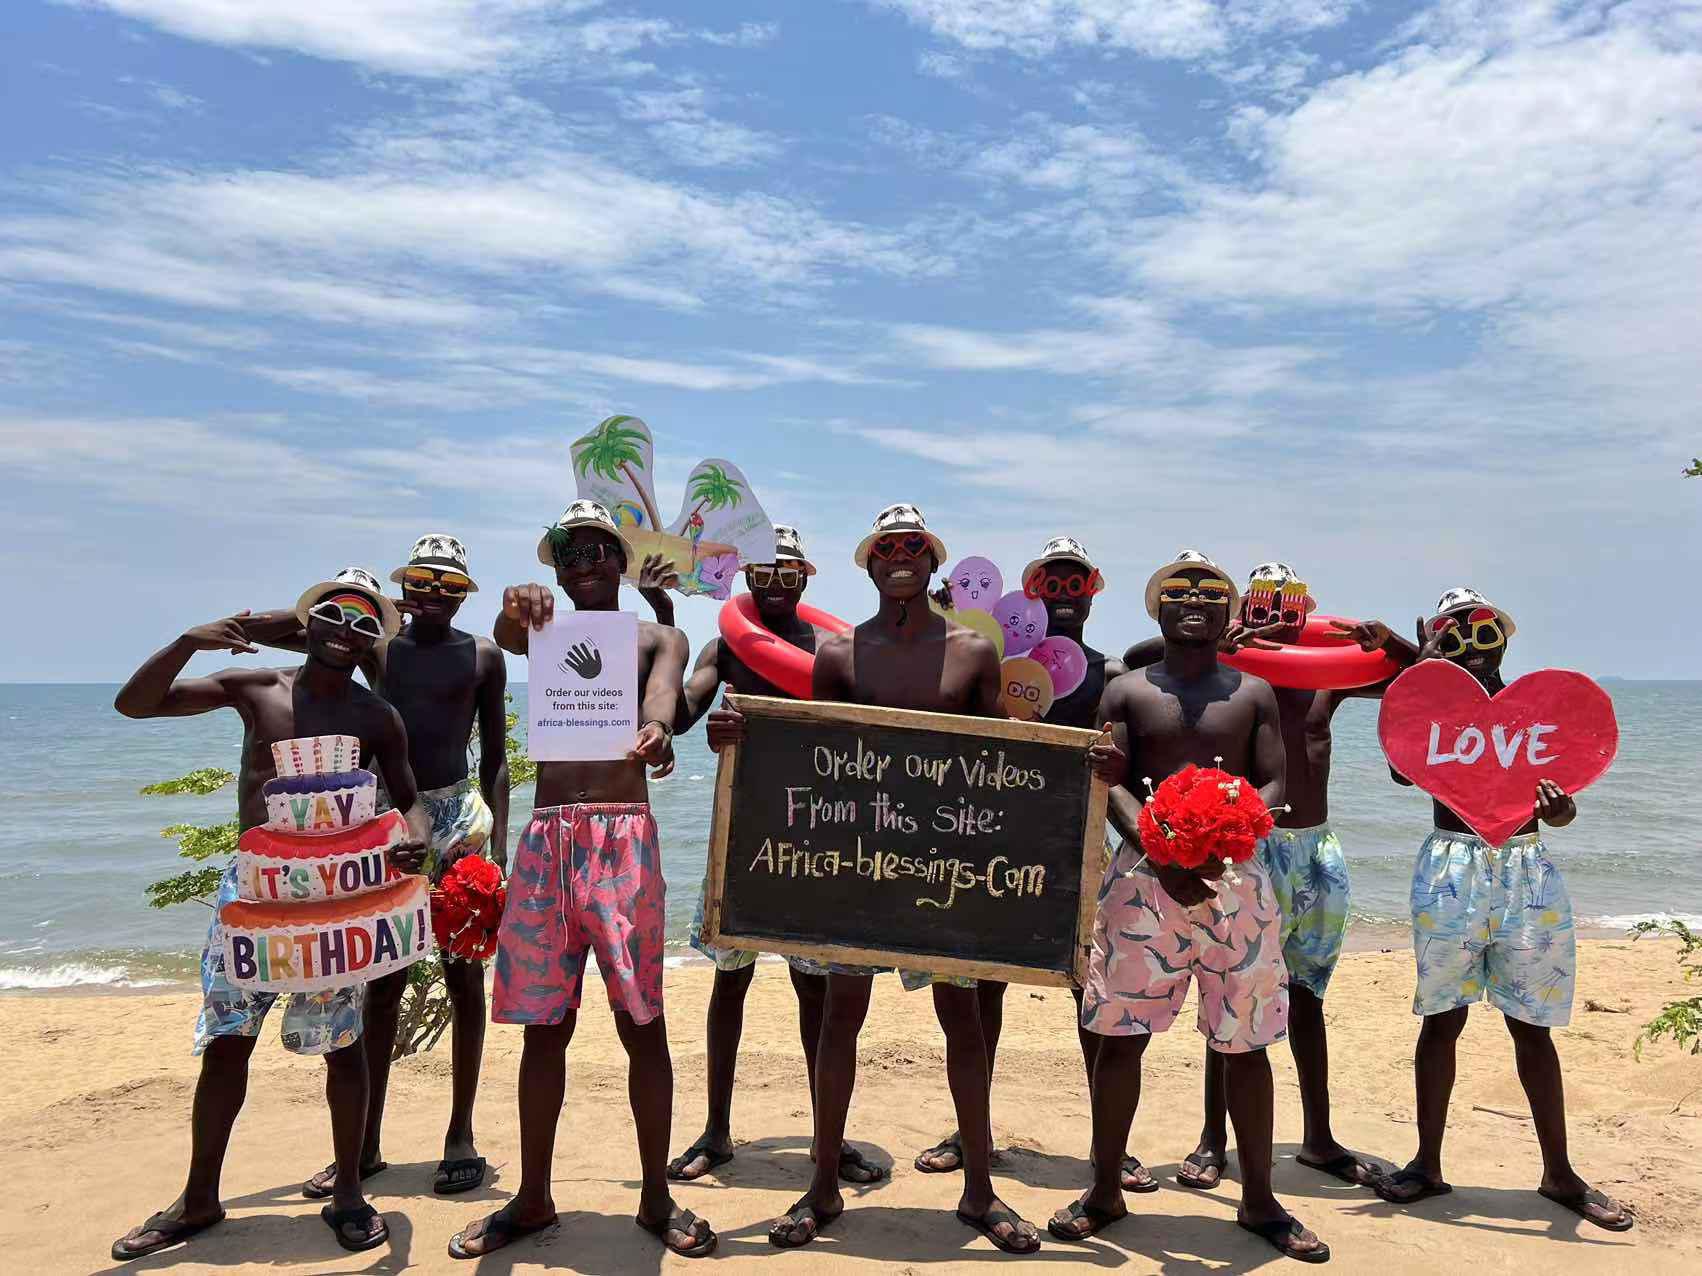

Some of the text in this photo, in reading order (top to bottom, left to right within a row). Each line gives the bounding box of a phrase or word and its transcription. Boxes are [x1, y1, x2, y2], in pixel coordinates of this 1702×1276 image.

[545, 688, 572, 697] Order
[592, 688, 623, 697] videos
[552, 701, 618, 710] from this site:
[537, 718, 631, 728] africa-blessings.com
[814, 736, 892, 782] Order
[1426, 722, 1560, 769] LOVE
[289, 793, 355, 831] YAY
[784, 787, 856, 830] From
[869, 791, 919, 833] this
[254, 863, 310, 900] IT'S
[232, 908, 425, 982] BIRTHDAY!
